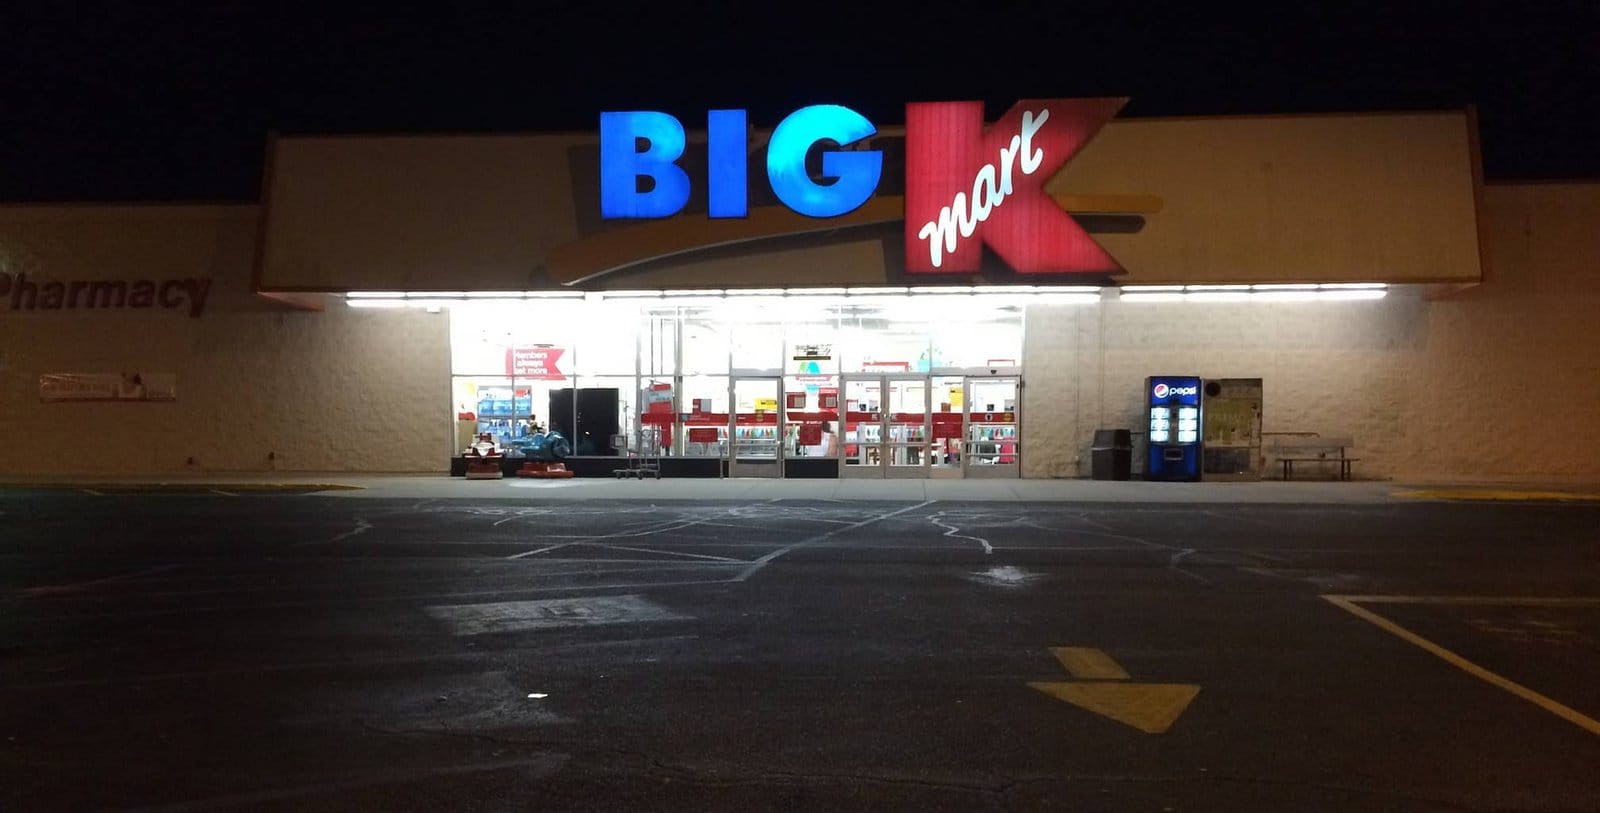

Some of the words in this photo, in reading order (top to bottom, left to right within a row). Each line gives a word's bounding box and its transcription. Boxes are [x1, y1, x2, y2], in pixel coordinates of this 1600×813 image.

[599, 104, 883, 219] BIG
[905, 97, 1130, 275] K
[918, 109, 1050, 268] mart
[1169, 386, 1197, 396] pepsi
